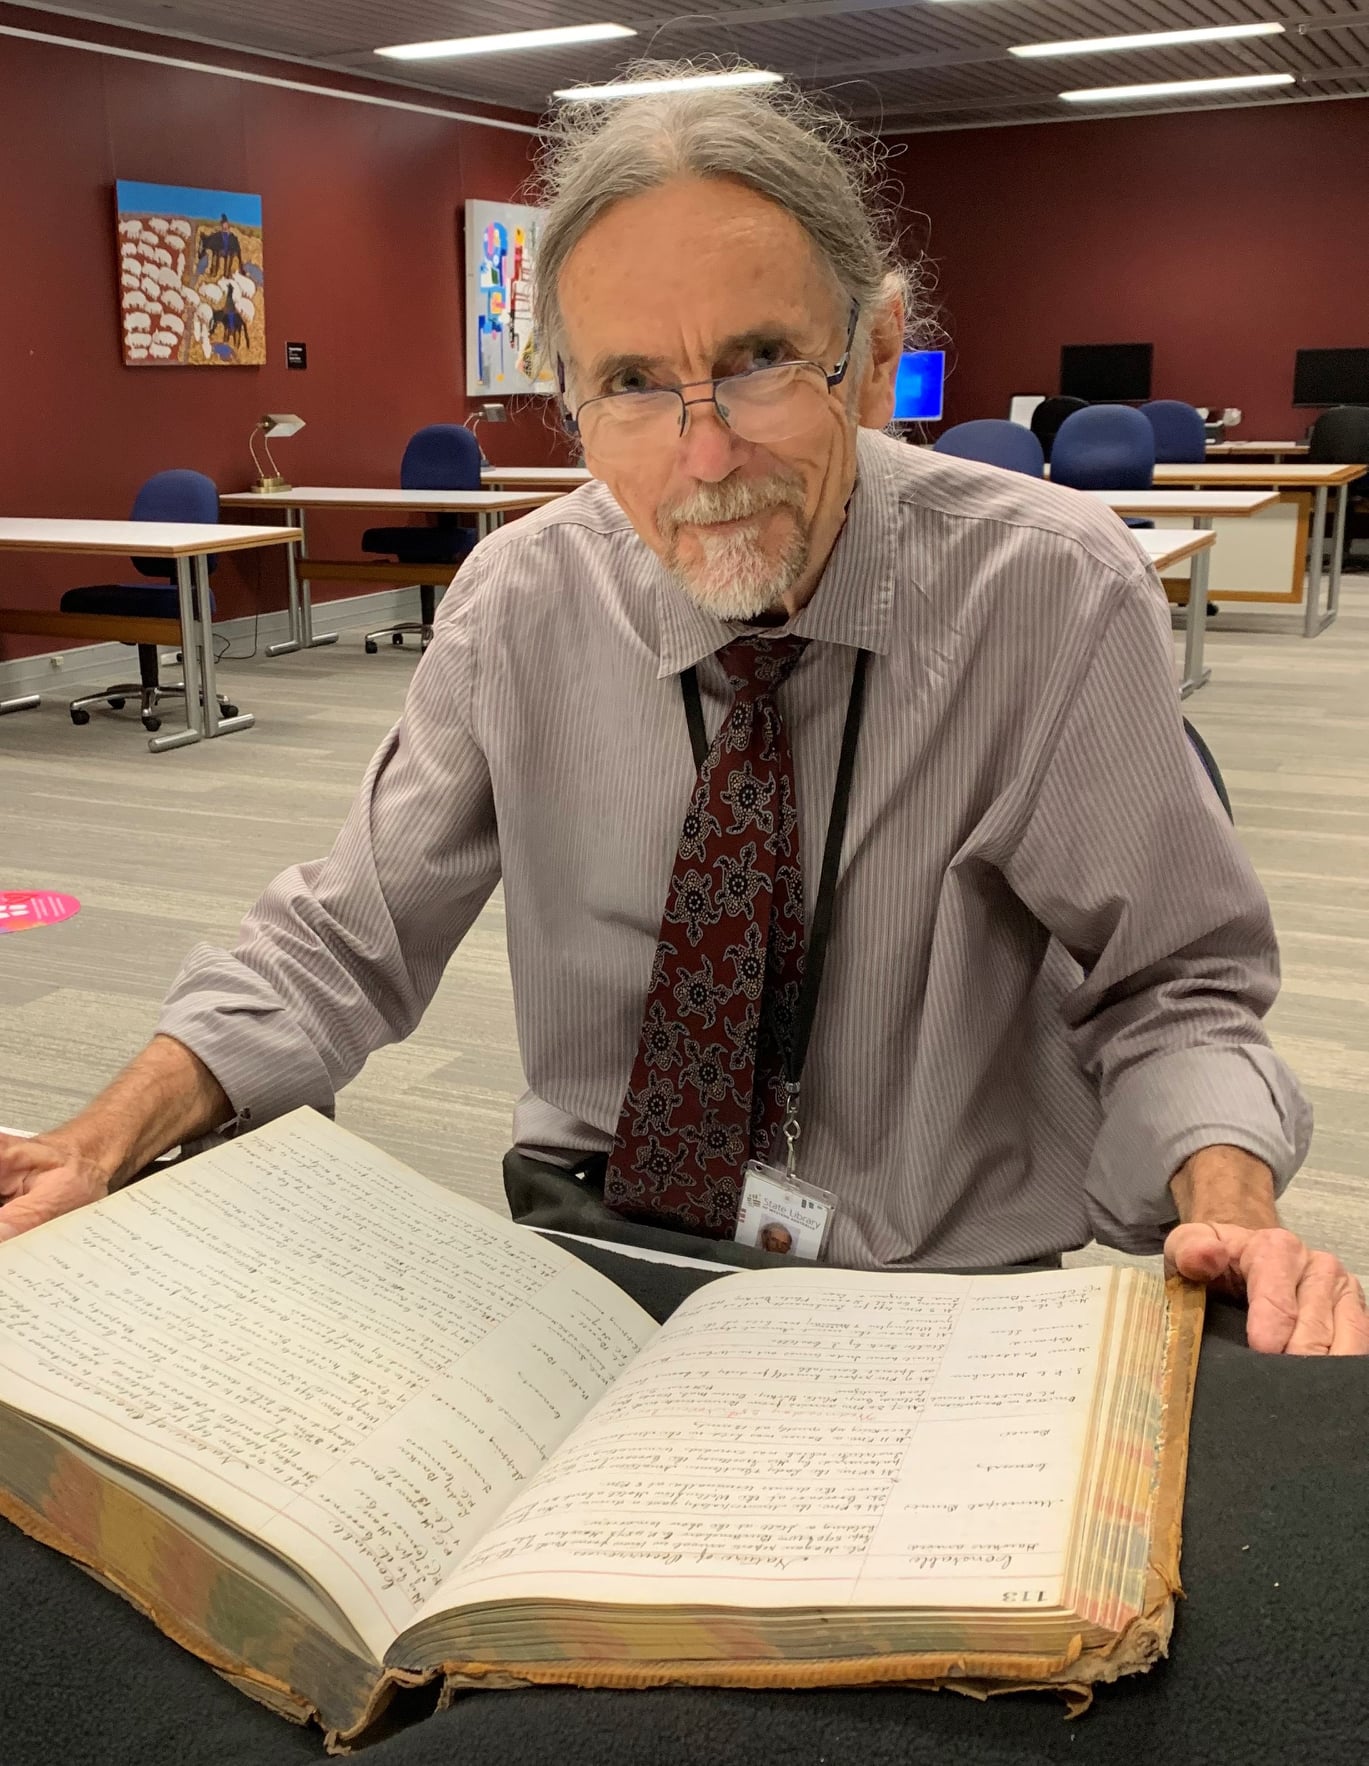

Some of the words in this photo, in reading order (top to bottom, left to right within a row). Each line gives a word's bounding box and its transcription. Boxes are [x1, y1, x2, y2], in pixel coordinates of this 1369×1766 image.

[763, 1198, 787, 1213] State
[790, 1208, 821, 1230] Library
[1003, 1591, 1045, 1602] 113
